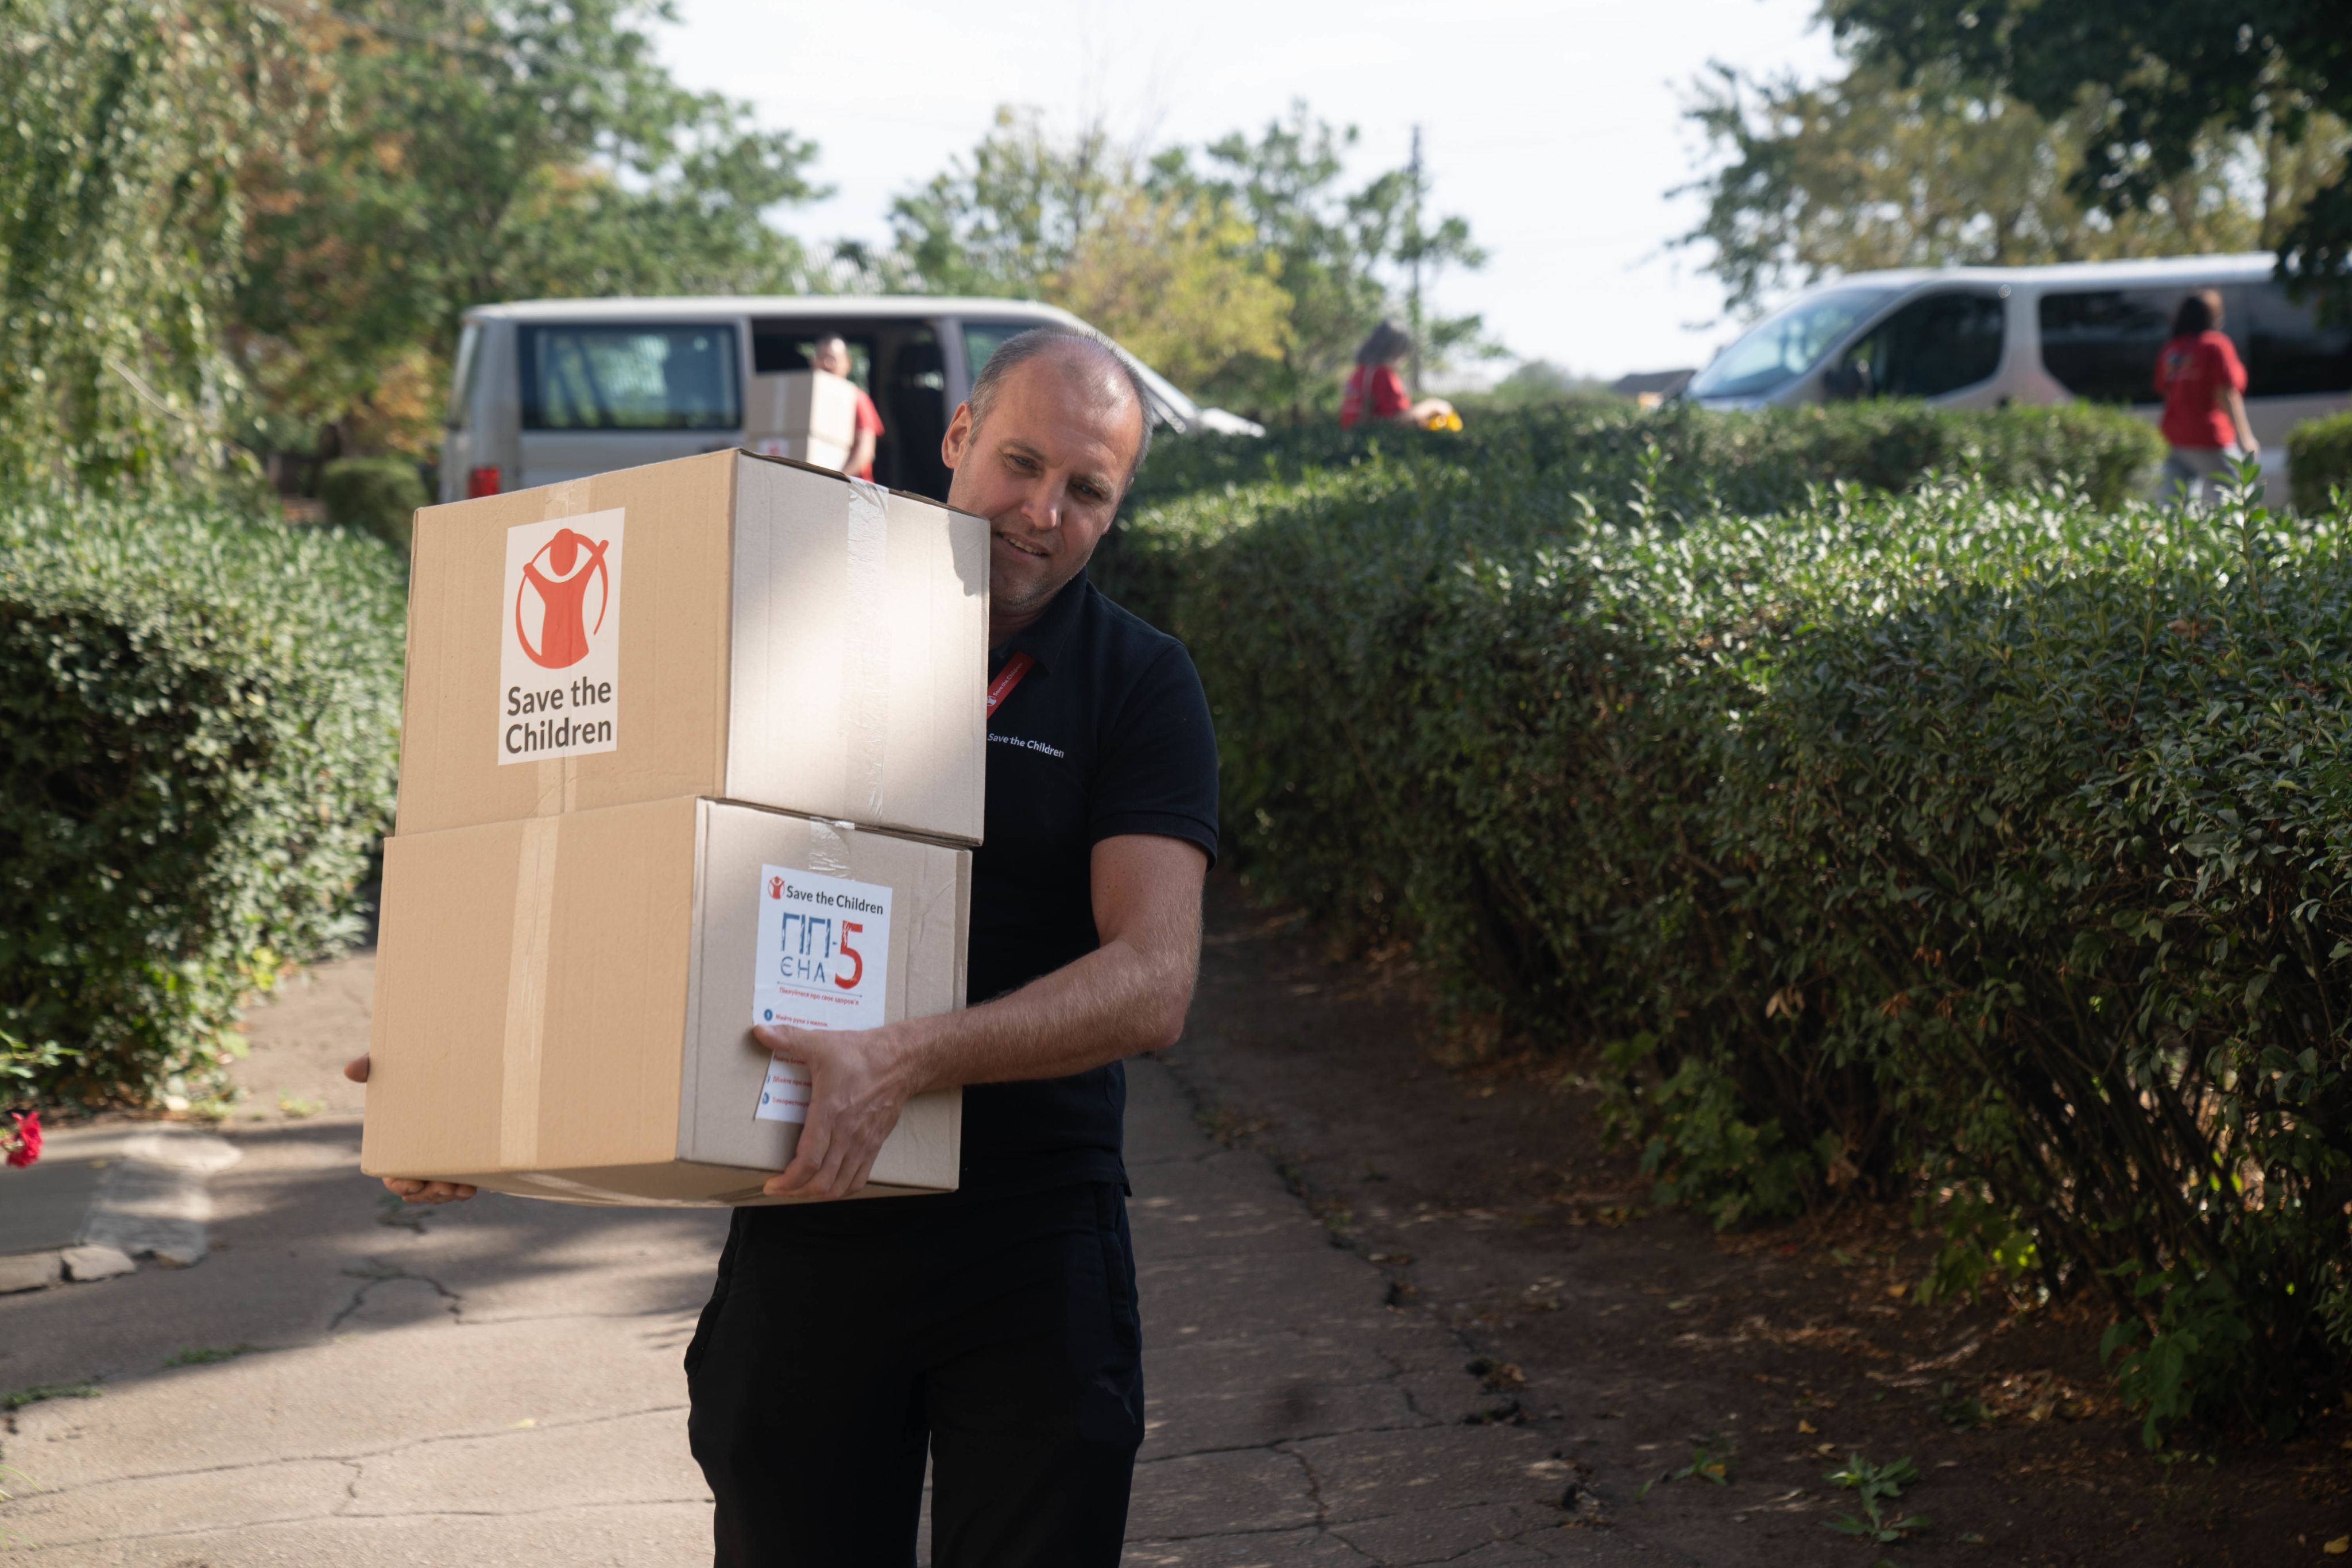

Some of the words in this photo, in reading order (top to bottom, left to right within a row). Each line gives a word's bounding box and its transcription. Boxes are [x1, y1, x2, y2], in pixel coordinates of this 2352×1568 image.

[506, 686, 563, 717] Save
[571, 676, 612, 707] the
[992, 686, 1004, 696] Save
[1001, 679, 1009, 687] the
[505, 717, 612, 754] Children
[987, 733, 1009, 743] Save
[1009, 737, 1026, 747] the
[1027, 740, 1065, 758] Children
[786, 885, 813, 902] Save
[816, 891, 834, 905] the
[836, 895, 884, 915] Children
[780, 956, 825, 983] ЄНА
[810, 993, 821, 1001] про
